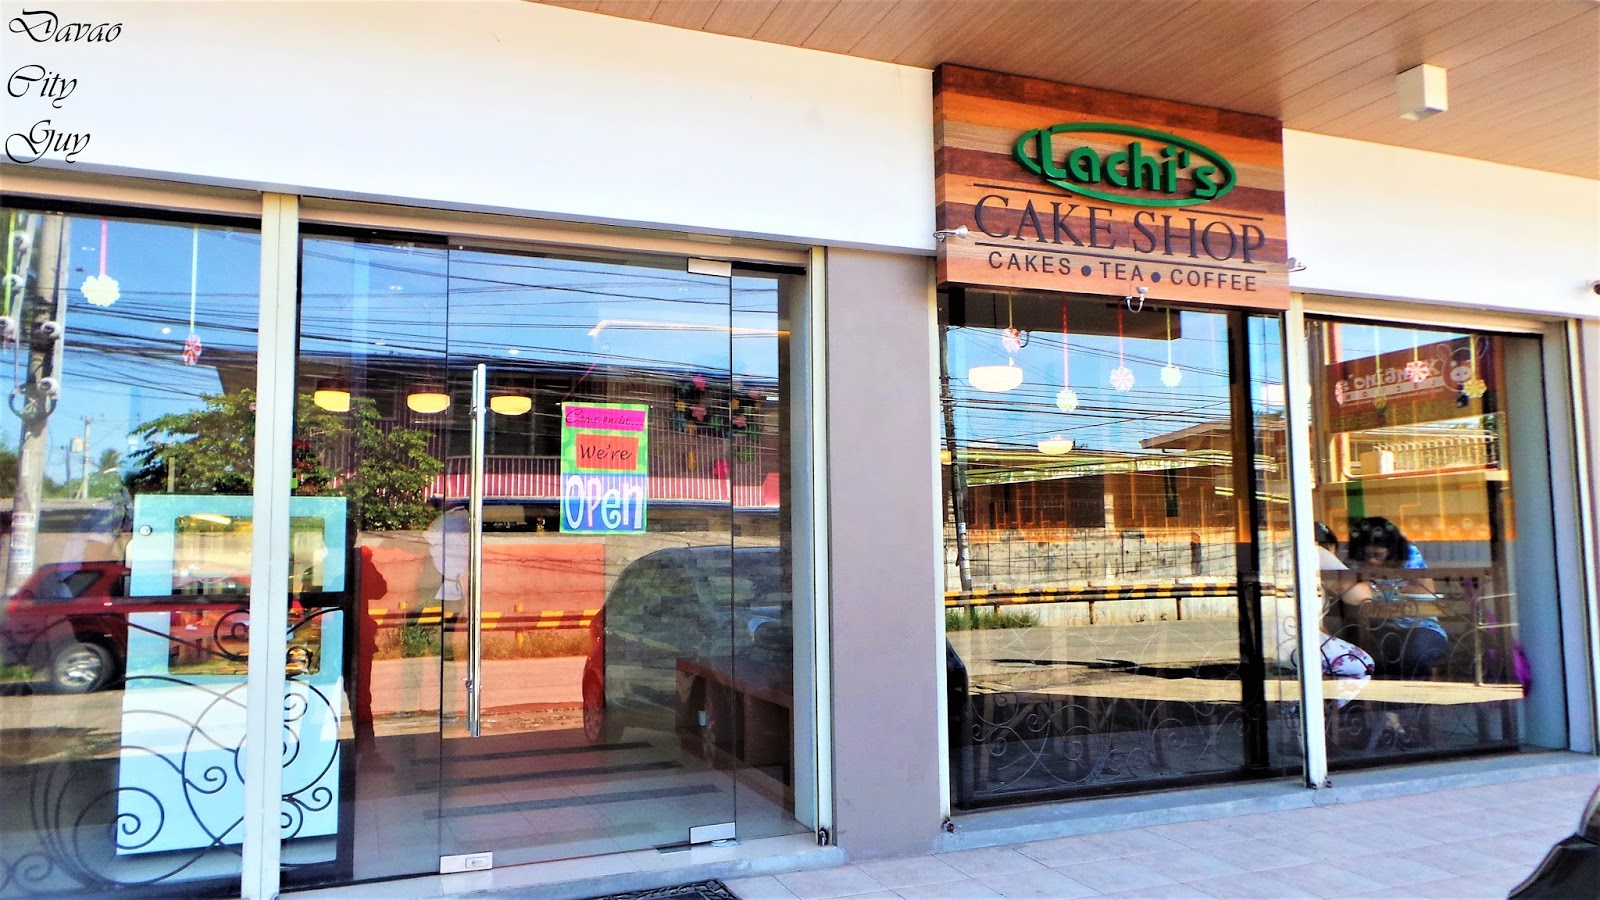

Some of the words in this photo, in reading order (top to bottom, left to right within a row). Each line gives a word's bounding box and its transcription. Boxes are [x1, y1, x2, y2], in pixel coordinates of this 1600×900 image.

[1035, 128, 1219, 200] Lachi's
[974, 194, 1116, 250] CAKE
[1133, 210, 1266, 264] SHOP
[988, 251, 1072, 276] CAKES
[1099, 261, 1144, 282] TEA
[1170, 268, 1258, 292] COFFEE
[580, 444, 633, 461] We're
